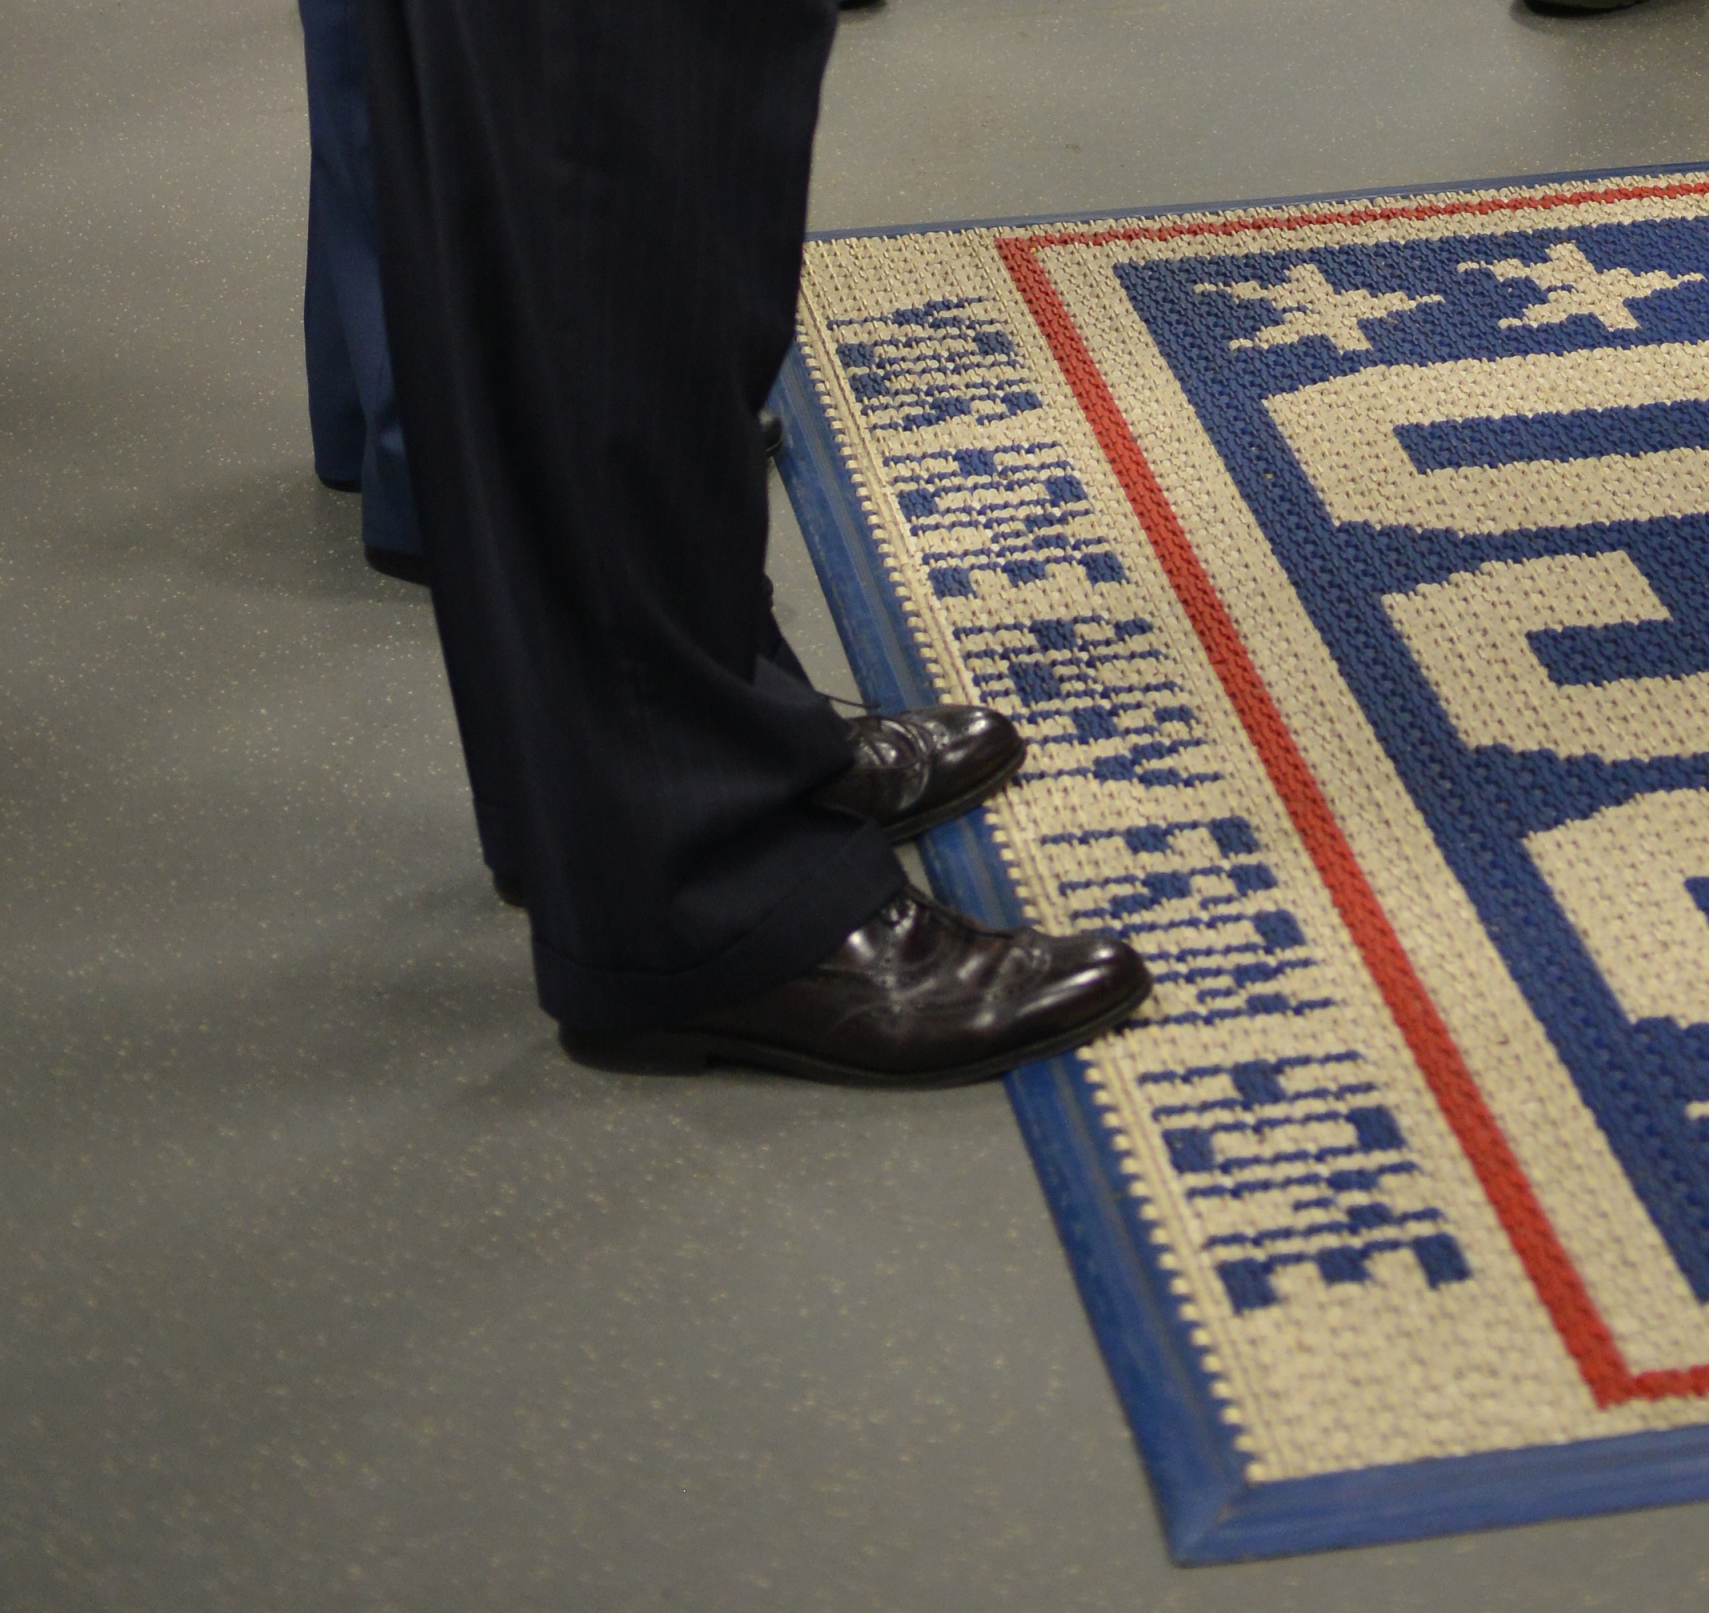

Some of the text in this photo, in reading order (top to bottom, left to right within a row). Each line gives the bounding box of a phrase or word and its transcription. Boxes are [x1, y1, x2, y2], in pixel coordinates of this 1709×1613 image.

[826, 295, 1474, 1315] YOUR HOME AWAY FROM HOME
